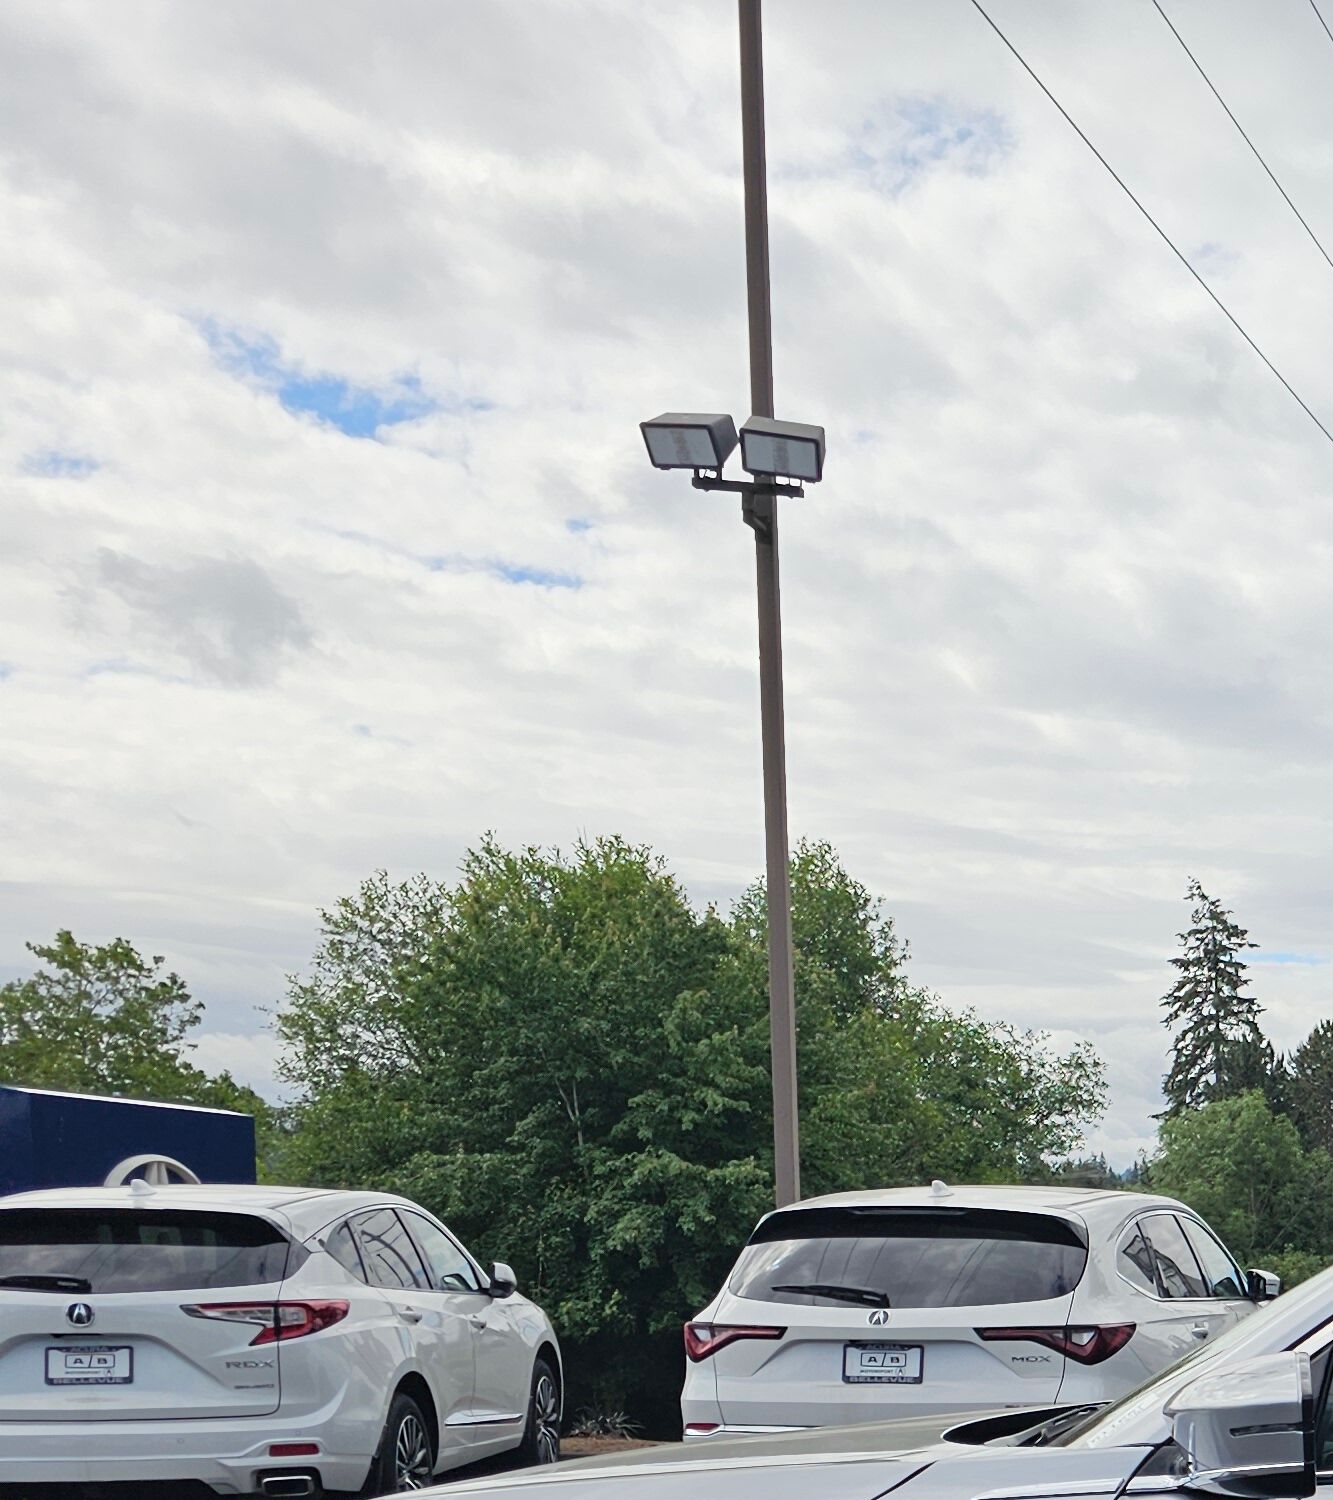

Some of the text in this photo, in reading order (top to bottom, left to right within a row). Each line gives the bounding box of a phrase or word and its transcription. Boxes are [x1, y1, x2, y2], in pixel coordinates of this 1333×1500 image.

[225, 1361, 274, 1369] RDX
[53, 1377, 123, 1385] BELLEVUE
[849, 1375, 914, 1383] BELLEVUE
